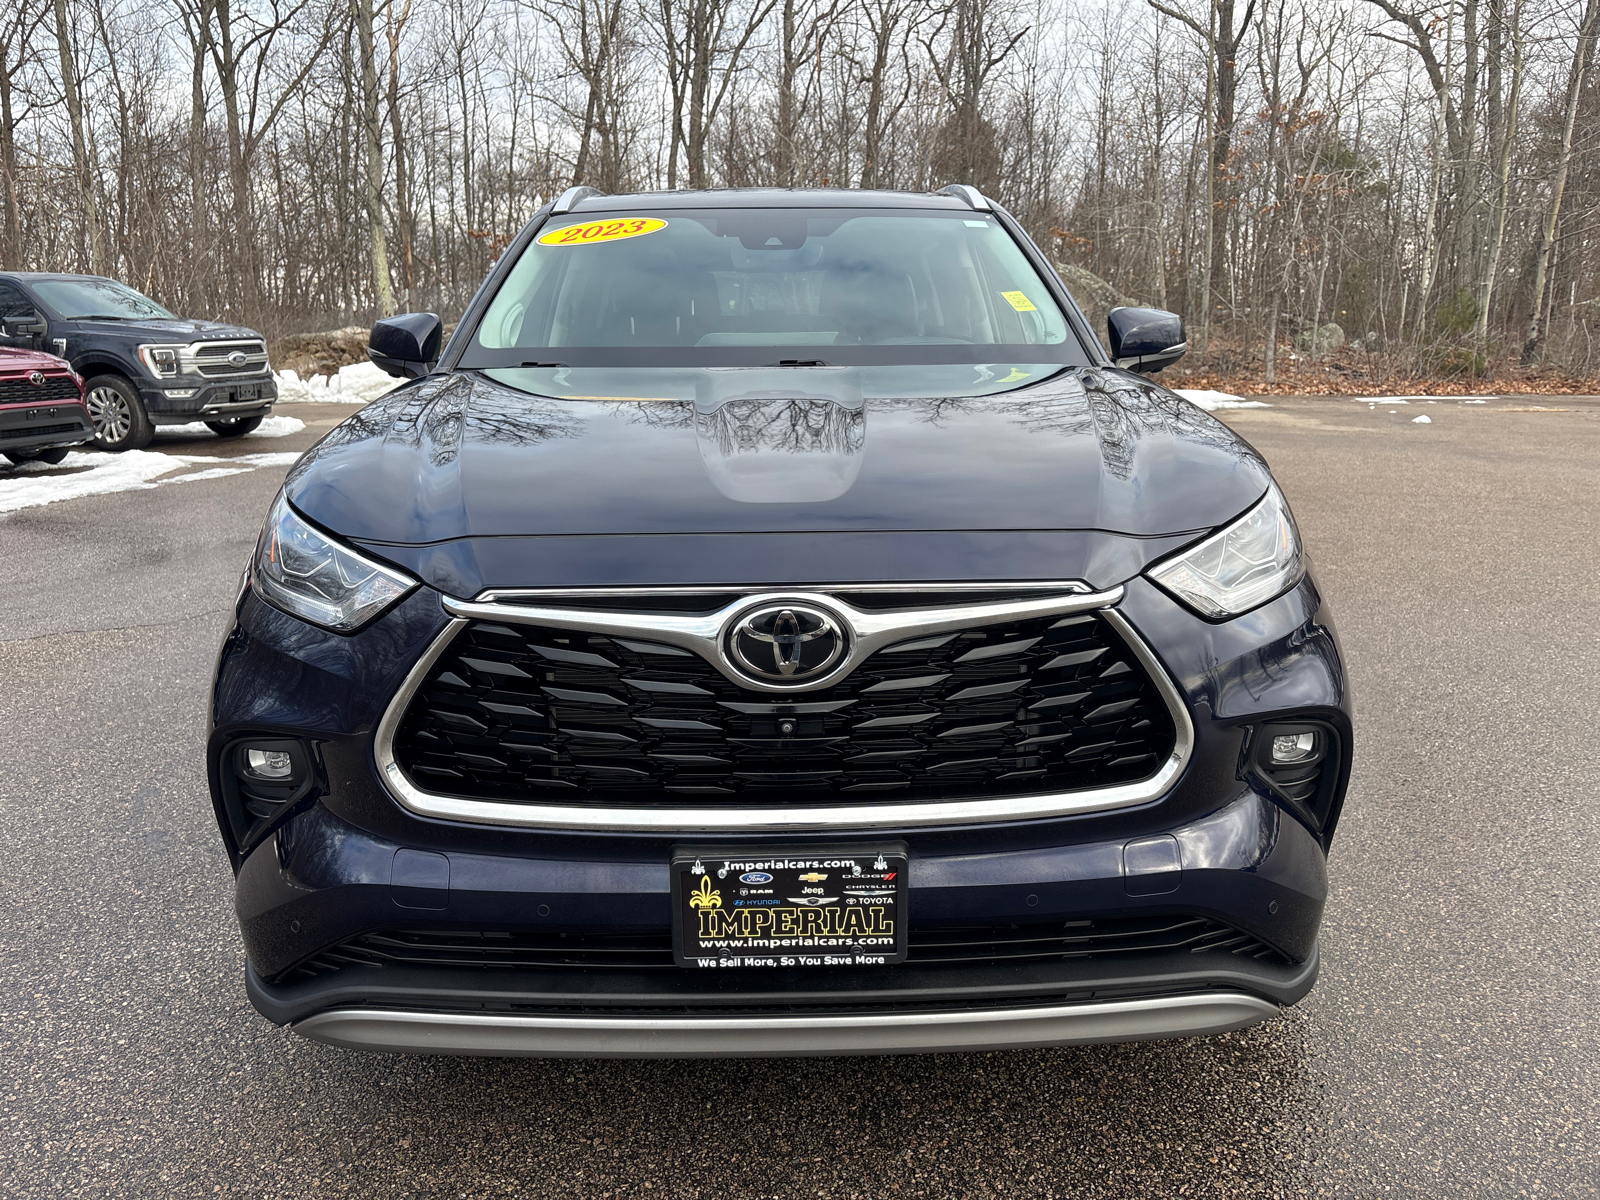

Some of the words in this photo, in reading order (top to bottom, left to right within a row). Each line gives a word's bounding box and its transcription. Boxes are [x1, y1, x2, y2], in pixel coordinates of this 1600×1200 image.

[559, 220, 646, 243] 2023
[724, 859, 855, 872] Imperialcars.com
[746, 874, 766, 882] Ford
[801, 887, 824, 895] Jeep
[699, 907, 893, 938] IMPERIAL
[699, 937, 893, 948] www.imperialcars.com
[698, 959, 716, 967] We
[720, 958, 740, 967] Sell
[745, 958, 777, 967] More,
[780, 957, 795, 966] So
[799, 957, 820, 965] You
[824, 956, 852, 965] Save
[856, 956, 884, 964] More
